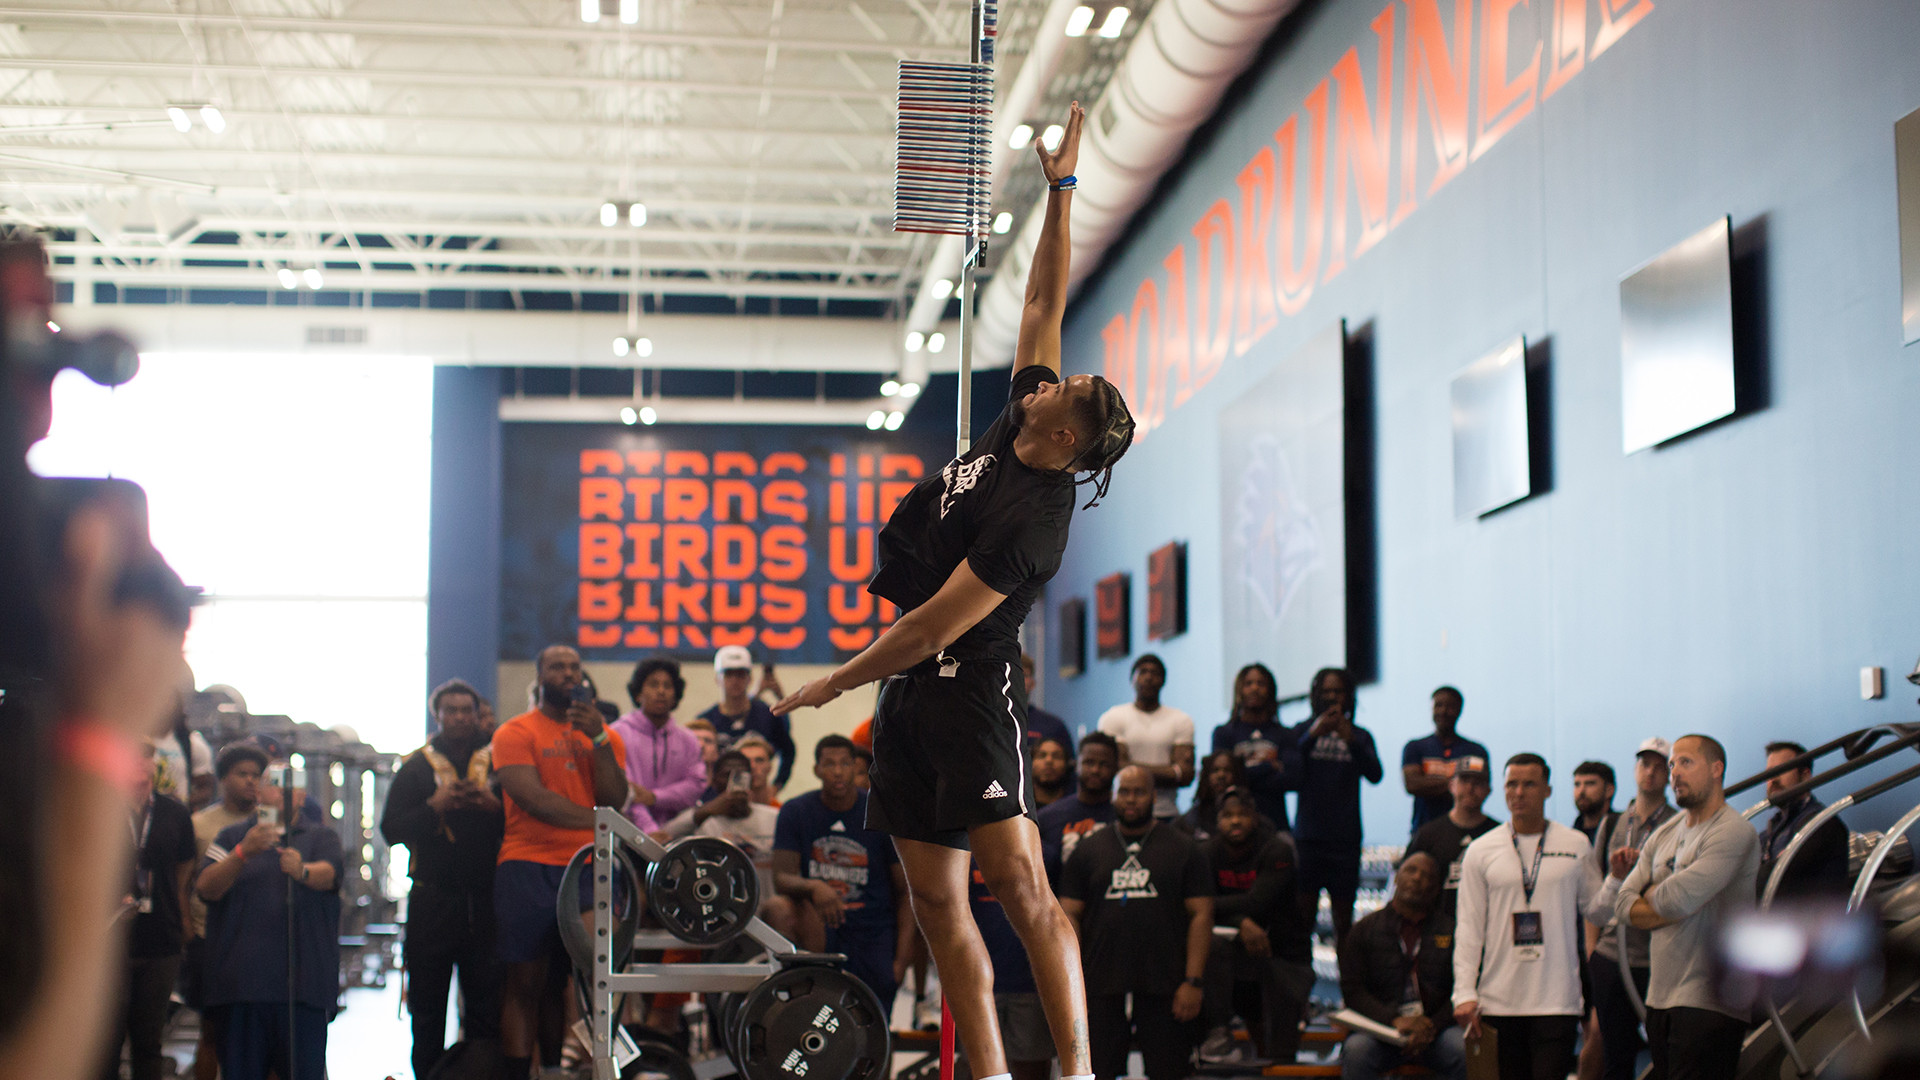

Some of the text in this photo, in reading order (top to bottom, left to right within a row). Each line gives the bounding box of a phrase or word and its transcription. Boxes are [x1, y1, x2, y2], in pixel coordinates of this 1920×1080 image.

[578, 523, 807, 581] BIRDS
[982, 790, 1008, 800] adidas
[825, 1017, 840, 1034] 45
[794, 1060, 809, 1078] 45
